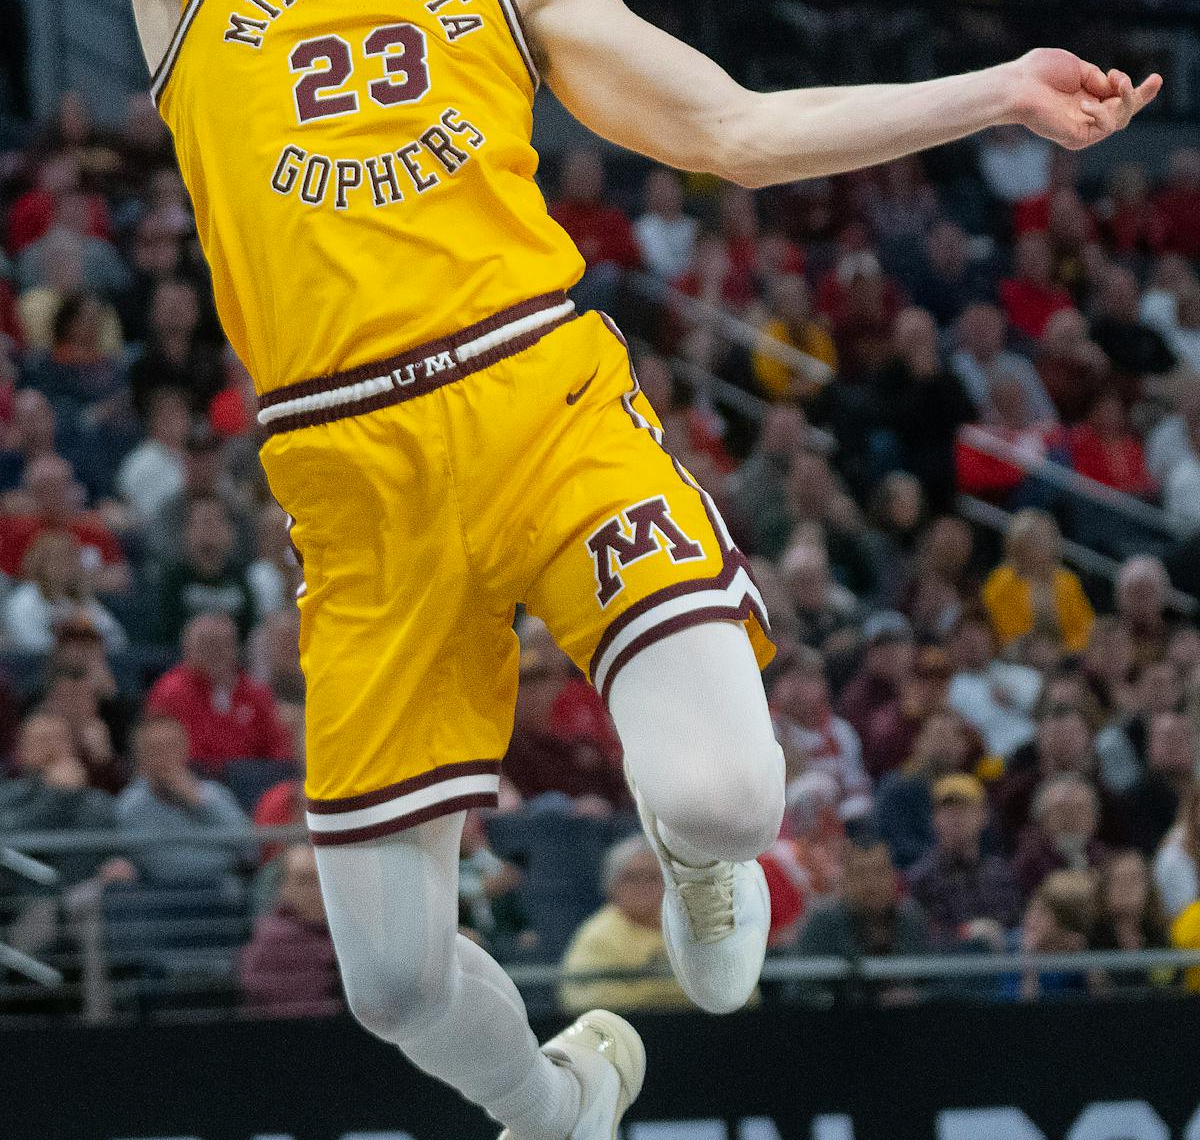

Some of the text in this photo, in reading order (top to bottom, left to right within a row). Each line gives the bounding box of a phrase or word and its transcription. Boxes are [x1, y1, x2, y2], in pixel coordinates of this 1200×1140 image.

[288, 22, 432, 124] 23
[270, 107, 486, 210] GOPHERS
[586, 494, 707, 609] M
